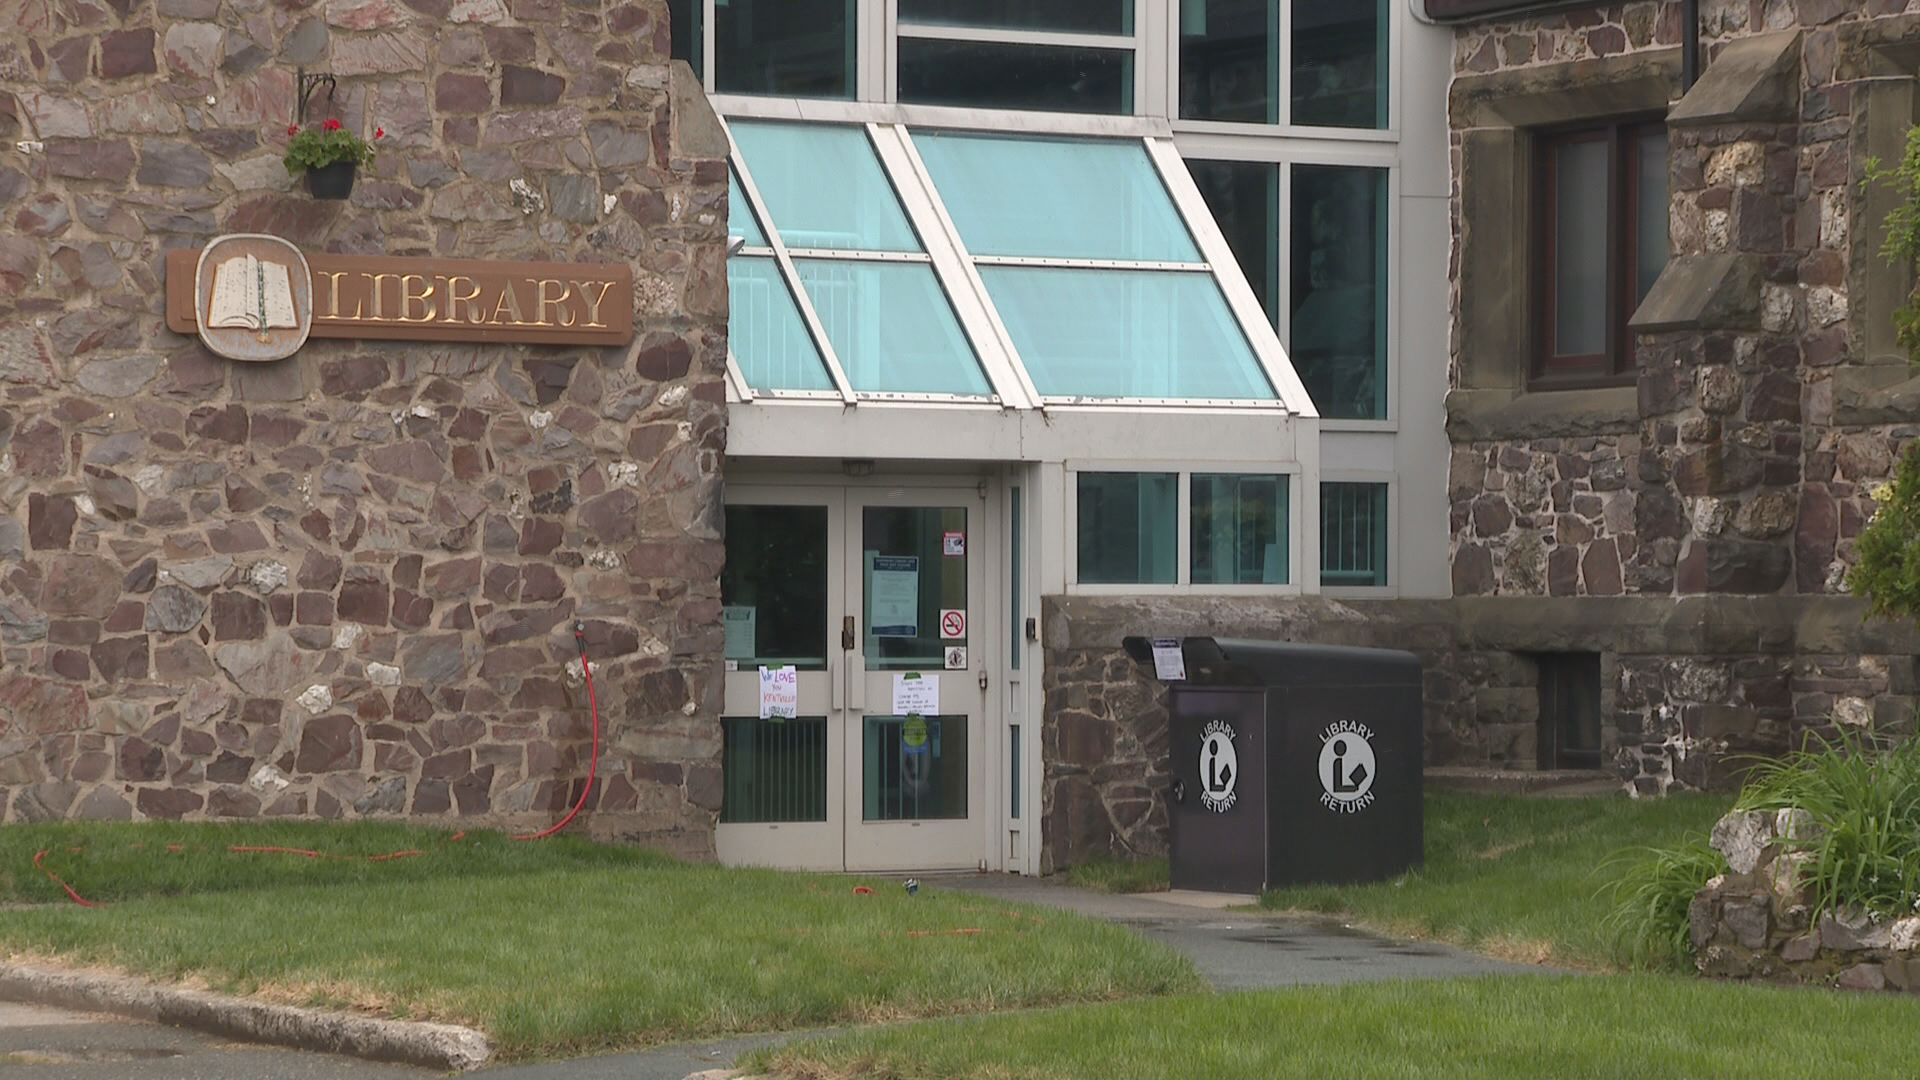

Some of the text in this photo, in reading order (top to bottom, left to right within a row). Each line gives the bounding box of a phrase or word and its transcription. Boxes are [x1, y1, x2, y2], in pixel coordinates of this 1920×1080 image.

[317, 271, 617, 328] LIBRARY
[775, 669, 796, 683] LOVE
[763, 706, 794, 717] LIBRARY
[1200, 720, 1237, 743] LIBRARY
[1319, 720, 1375, 743] LIBRARY
[1200, 790, 1237, 813] RETURN
[1320, 790, 1376, 813] RETURN
